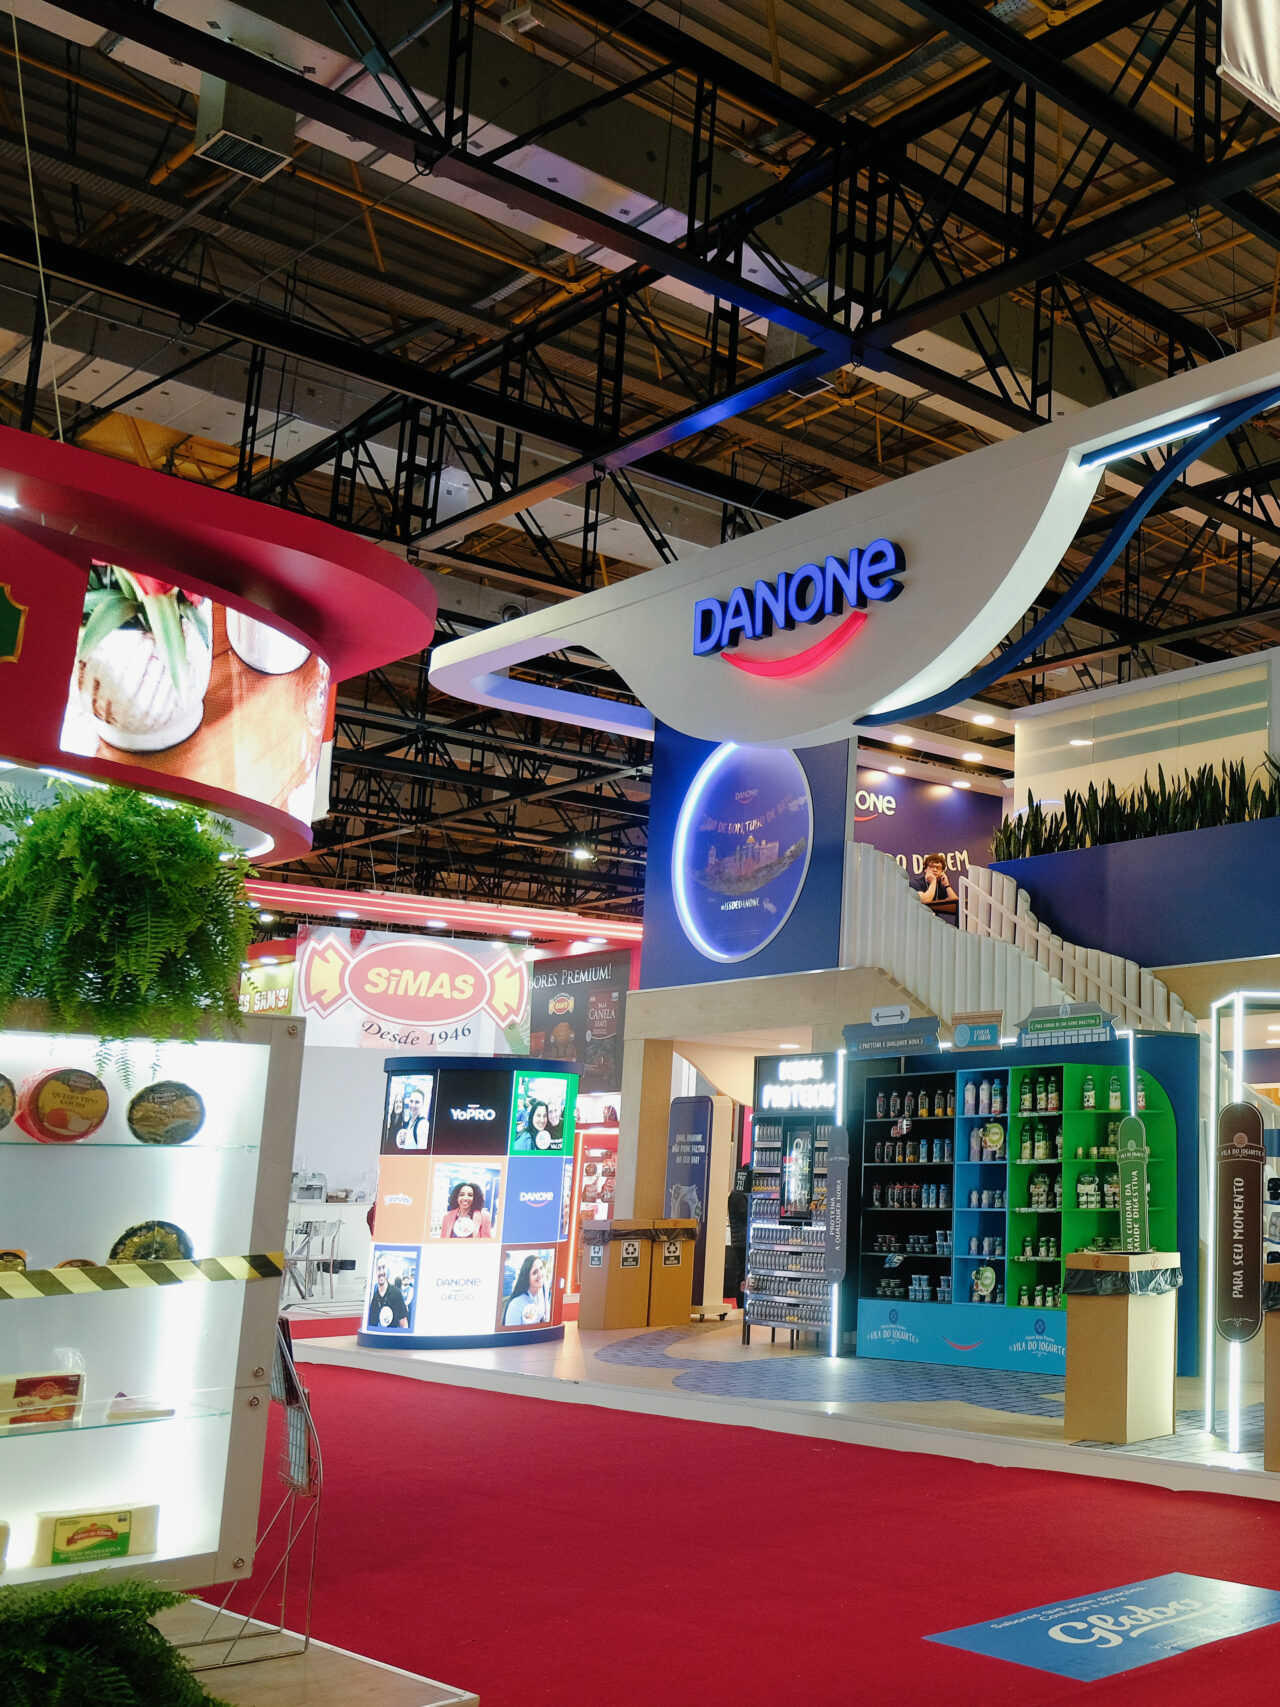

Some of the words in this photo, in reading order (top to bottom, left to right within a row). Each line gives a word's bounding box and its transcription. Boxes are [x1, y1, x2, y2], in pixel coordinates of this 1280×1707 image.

[561, 963, 612, 986] PREMIUM!
[589, 1008, 616, 1020] CANELA
[362, 1020, 421, 1047] Desde
[427, 1022, 472, 1047] 1946
[450, 1108, 496, 1121] YoPRO
[835, 1179, 843, 1200] HORA
[1125, 1183, 1132, 1196] DA
[1131, 1170, 1140, 1219] DIGESTIVA
[1125, 1200, 1133, 1234] CUIDAR
[1232, 1177, 1245, 1240] MOMENTO
[1232, 1242, 1245, 1266] SEU
[1232, 1269, 1245, 1299] PARA
[882, 1329, 892, 1339] DO
[1013, 1341, 1026, 1352] VILA
[1027, 1341, 1037, 1350] DO
[1038, 1341, 1066, 1357] IOGURTE
[1047, 1598, 1204, 1649] Globo
